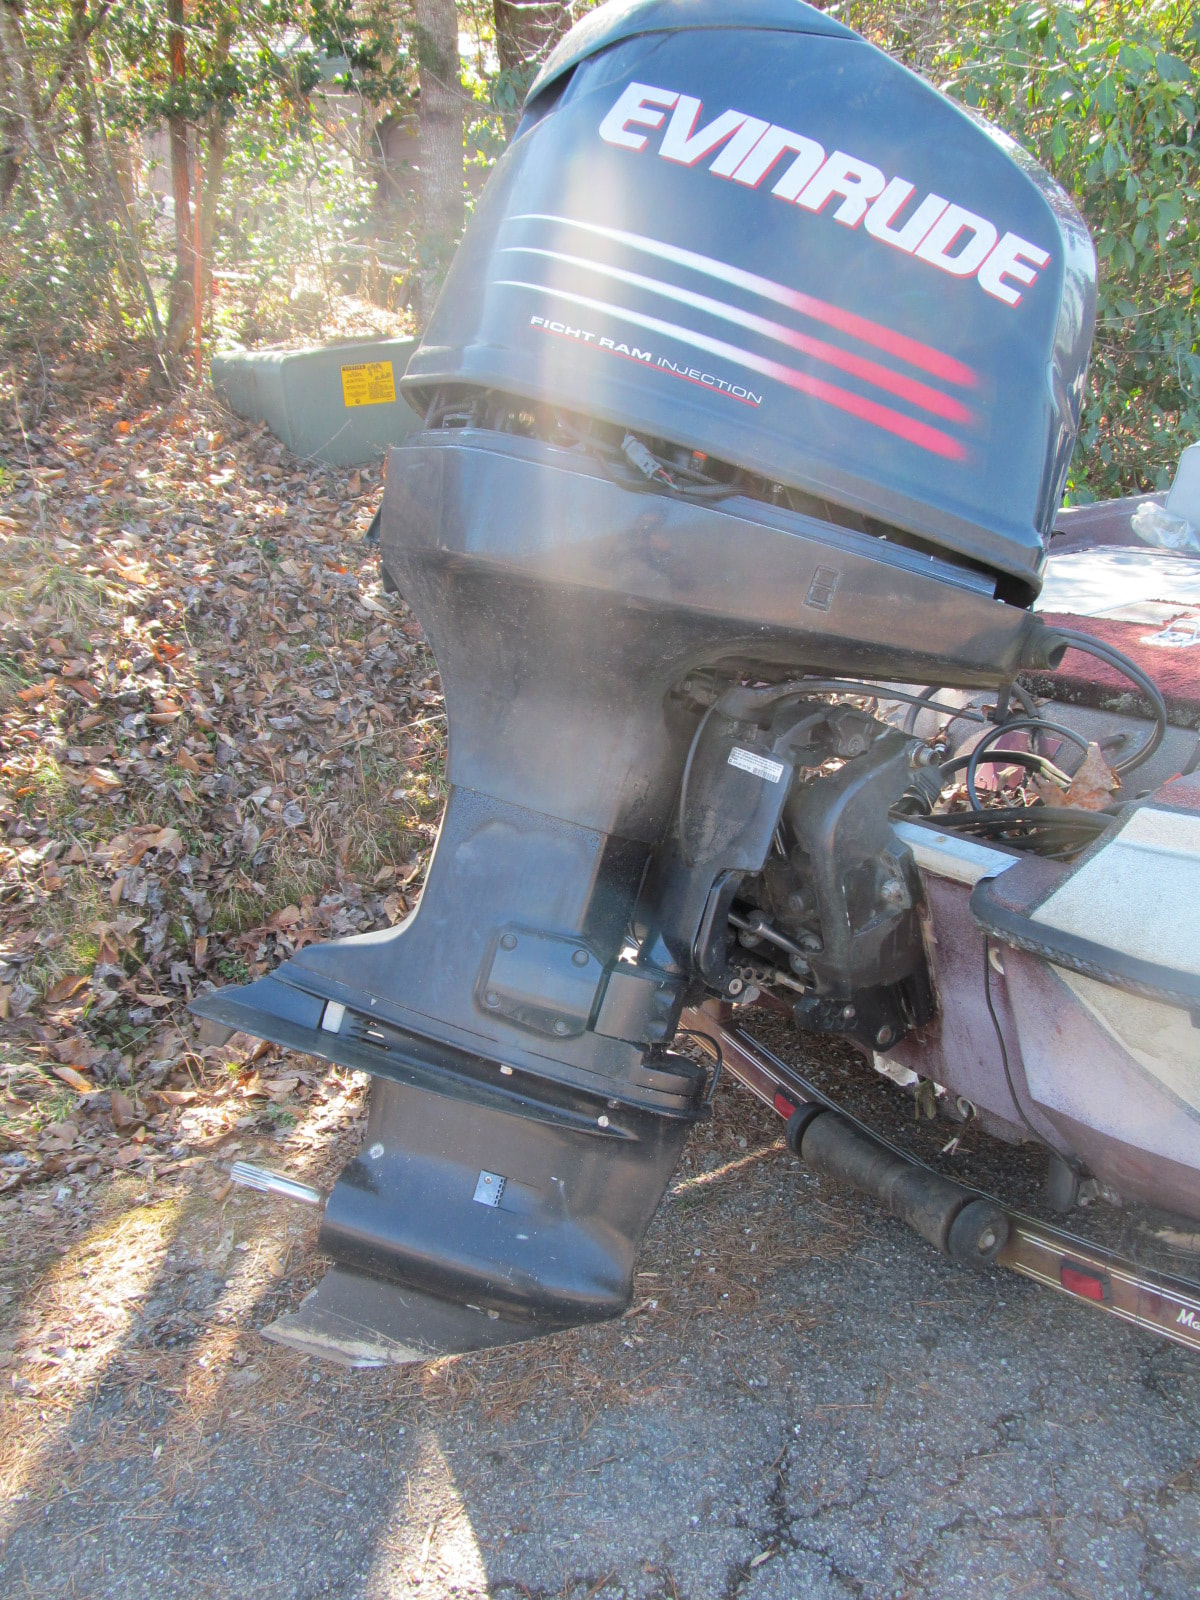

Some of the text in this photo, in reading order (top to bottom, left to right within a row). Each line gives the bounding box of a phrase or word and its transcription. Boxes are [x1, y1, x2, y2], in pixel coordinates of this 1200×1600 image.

[598, 82, 1051, 308] EVINRUDE
[530, 315, 763, 405] FICHT RAM INJECTION
